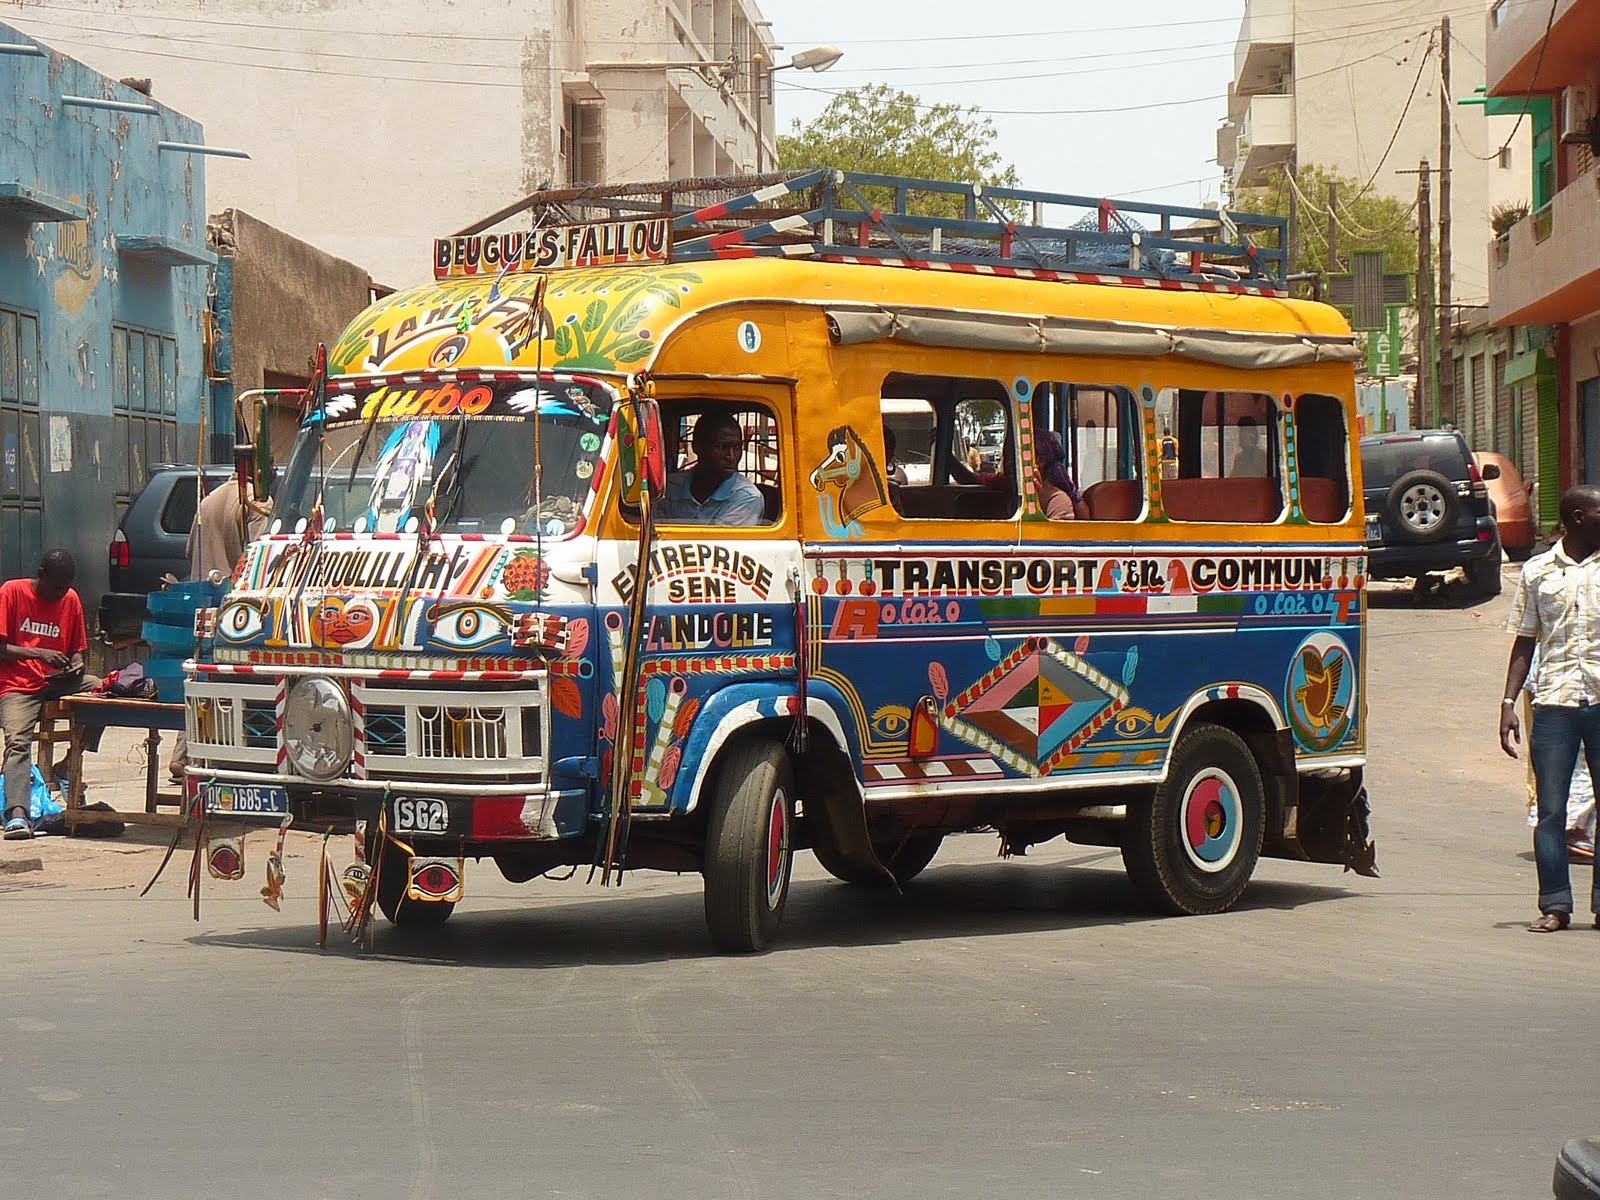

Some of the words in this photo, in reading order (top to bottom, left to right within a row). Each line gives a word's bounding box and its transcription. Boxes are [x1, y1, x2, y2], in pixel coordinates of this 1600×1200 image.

[361, 383, 493, 417] turbo
[669, 576, 737, 603] SENE
[873, 559, 1098, 597] TRANSPORT
[1190, 558, 1323, 592] COMMUN
[20, 617, 60, 638] Annie
